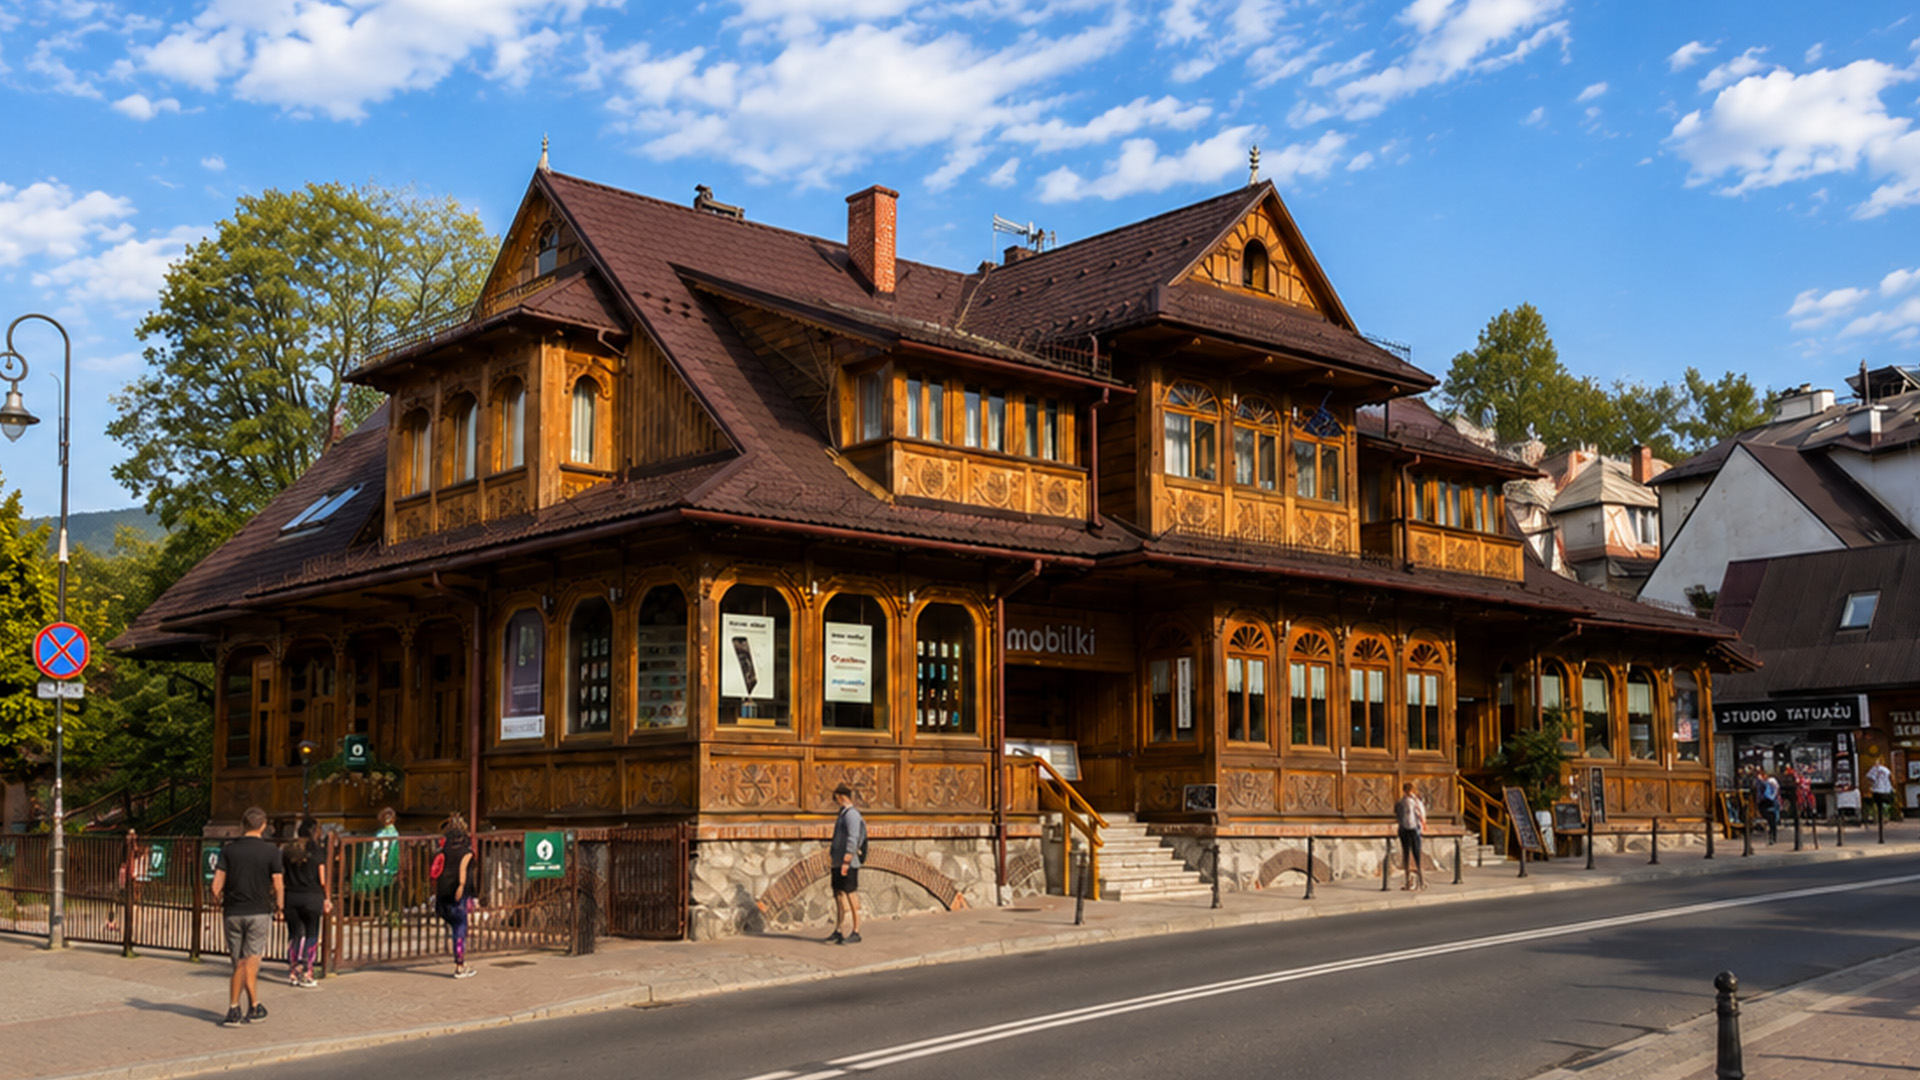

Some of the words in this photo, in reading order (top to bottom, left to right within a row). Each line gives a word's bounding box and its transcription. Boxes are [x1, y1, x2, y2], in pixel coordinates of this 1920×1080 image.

[1006, 624, 1095, 655] mobilki
[1722, 709, 1777, 723] STUDIO
[1785, 702, 1851, 720] TATUAŻU
